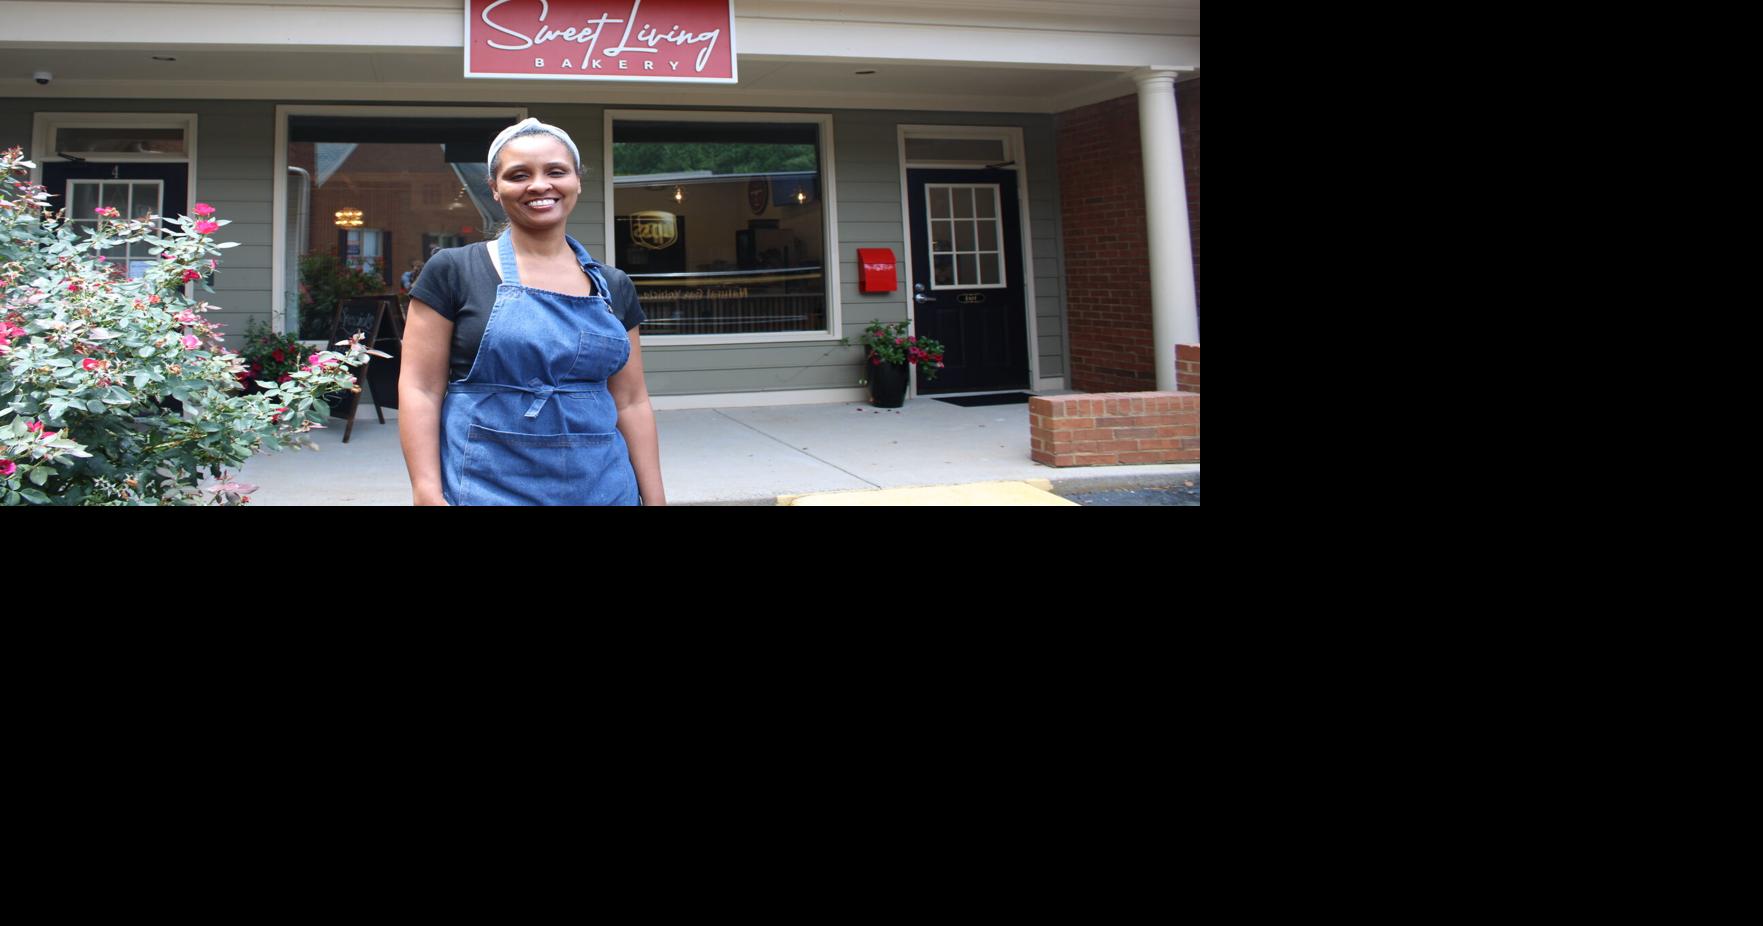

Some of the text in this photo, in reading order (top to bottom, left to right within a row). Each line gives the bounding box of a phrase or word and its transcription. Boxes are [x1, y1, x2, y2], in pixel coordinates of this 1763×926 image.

[481, 0, 720, 72] Sweet Living
[535, 57, 680, 71] BAKERY
[111, 164, 119, 179] 4
